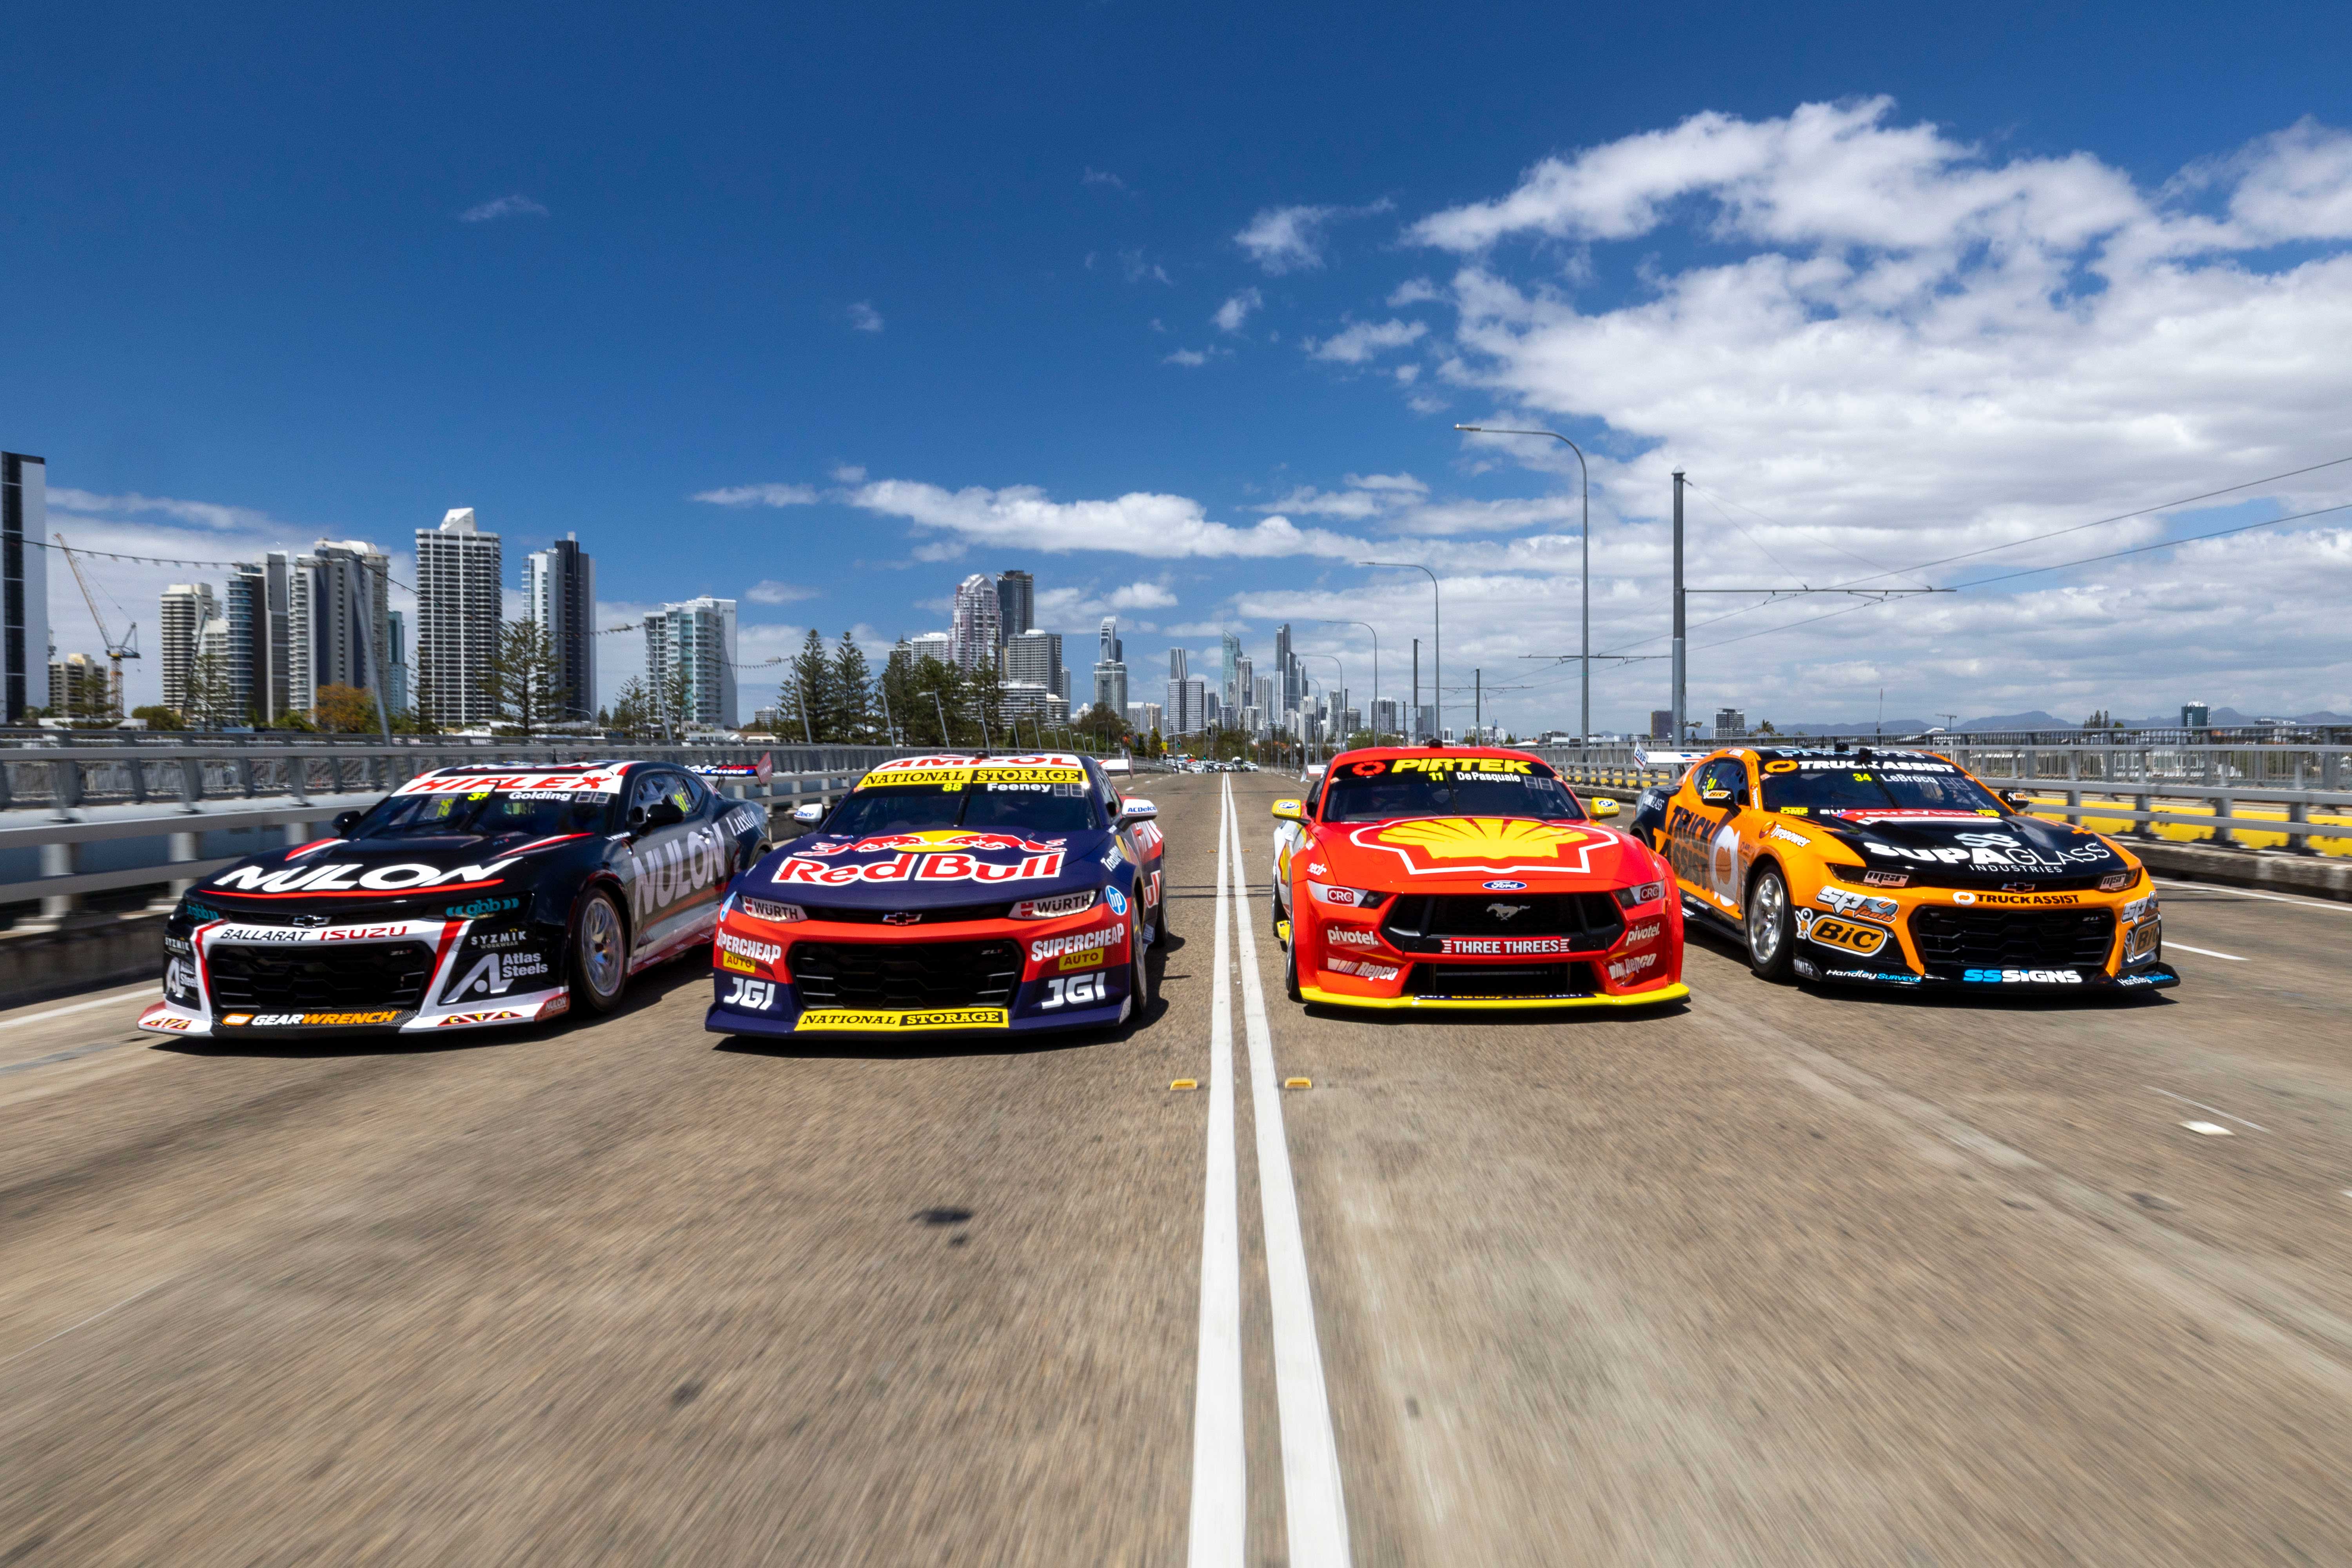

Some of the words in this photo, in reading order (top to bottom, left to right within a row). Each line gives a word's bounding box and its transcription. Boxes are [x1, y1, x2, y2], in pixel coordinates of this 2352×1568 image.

[1635, 749, 1646, 763] DAF
[878, 757, 1078, 770] AMPOL
[1392, 758, 1532, 774] PIRTEK
[1798, 760, 1880, 769] TRUCK
[1882, 761, 1955, 773] ASSIST
[864, 771, 965, 785] NATIONAL
[977, 770, 1078, 781] STORAGE
[1429, 772, 1443, 781] 11
[1853, 773, 1872, 782] 34
[405, 777, 612, 793] HIFLEX
[942, 783, 963, 792] 88
[987, 783, 1051, 793] Feeney
[509, 791, 572, 801] Golding
[214, 857, 524, 893] NULON
[632, 822, 725, 924] NULON
[775, 852, 915, 885] Red
[919, 851, 1062, 883] Bull
[1969, 864, 2063, 873] INDUSTRIES
[1328, 890, 1352, 902] CRC
[1641, 887, 1659, 899] CRC
[1976, 894, 2032, 904] TRUCK
[2033, 895, 2079, 904] ASSIST
[220, 929, 311, 941] BALLARAT
[319, 926, 407, 940] ISUZU
[471, 931, 527, 945] SYZMIK
[480, 941, 519, 949] WORKWEAR
[1031, 923, 1125, 962] SUPERCHEAP
[1453, 941, 1501, 953] THREE
[1504, 940, 1559, 953] THREES
[502, 952, 541, 966] Atlas
[726, 955, 752, 969] AUTO
[1063, 952, 1099, 966] AUTO
[502, 962, 548, 978] Steels
[1355, 961, 1399, 981] Repco
[1826, 970, 1878, 980] Handley
[723, 976, 776, 1011] JGI
[1041, 972, 1106, 1009] JGI
[802, 1015, 896, 1024] NATIONAL
[907, 1012, 999, 1024] STORAGE
